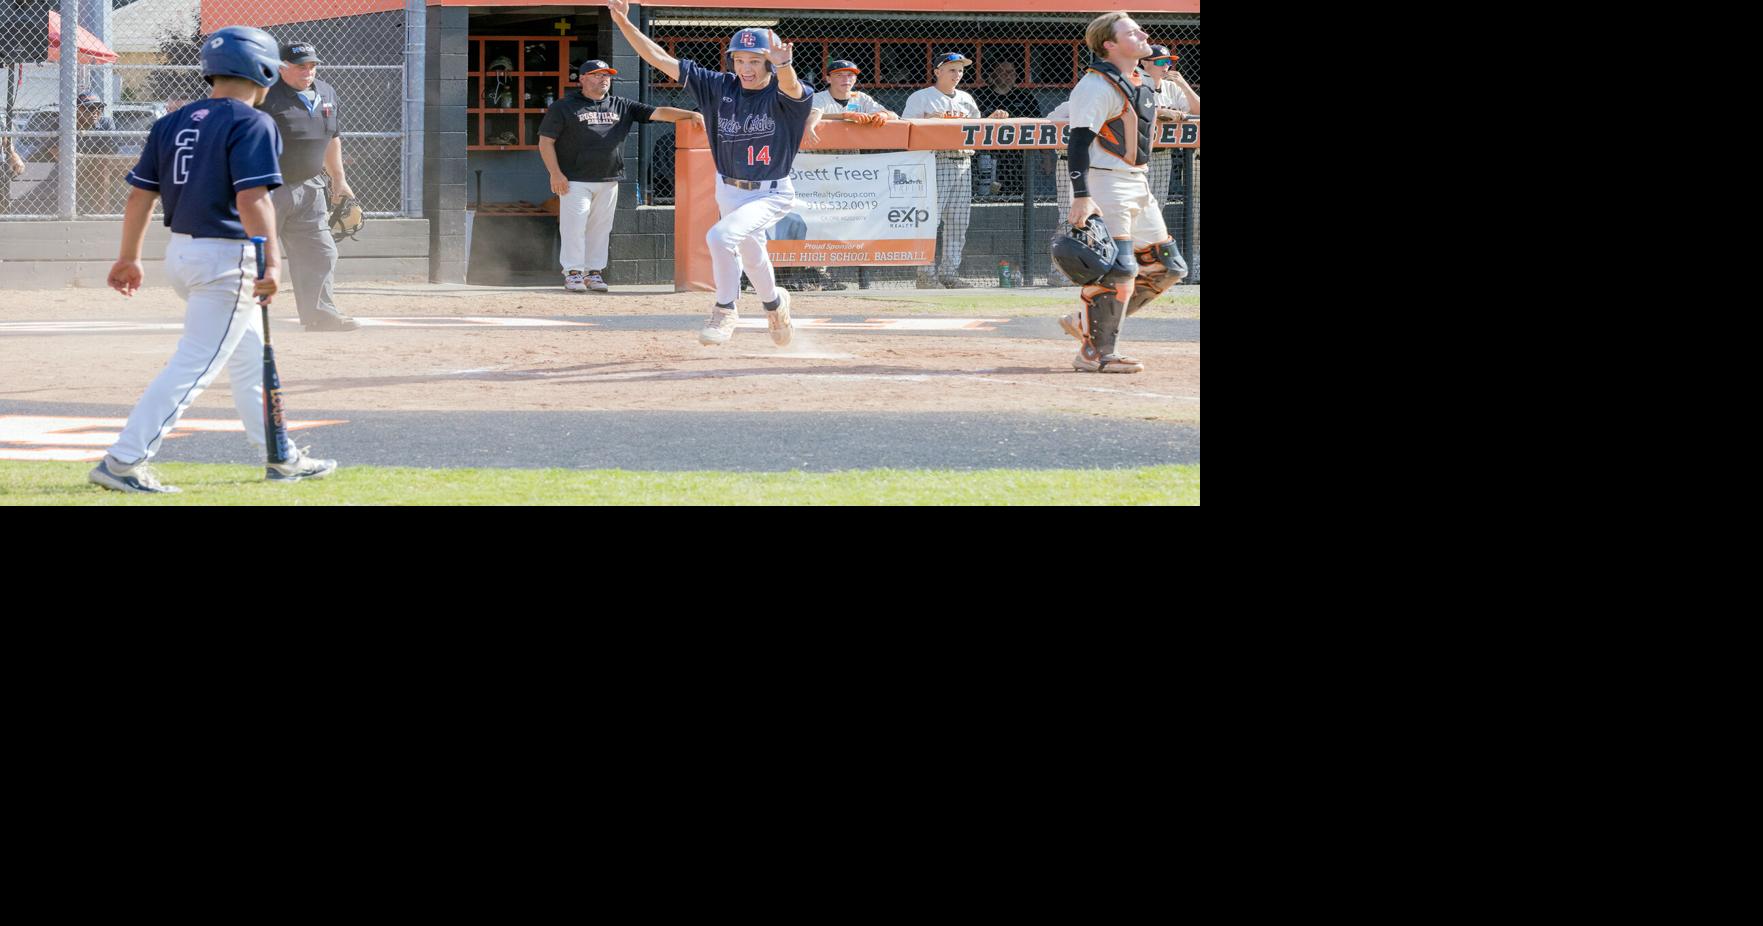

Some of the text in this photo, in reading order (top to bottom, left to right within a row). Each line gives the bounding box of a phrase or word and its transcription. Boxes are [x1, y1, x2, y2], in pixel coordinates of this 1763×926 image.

[1153, 122, 1198, 145] EB
[747, 145, 771, 166] 14
[789, 166, 880, 181] Brett Freer
[807, 200, 878, 210] 916.532.0019
[804, 242, 825, 250] Proud
[855, 242, 864, 250] of
[800, 252, 826, 262] HIGH
[830, 252, 870, 262] SCHOOL
[874, 251, 928, 262] BASEBALL
